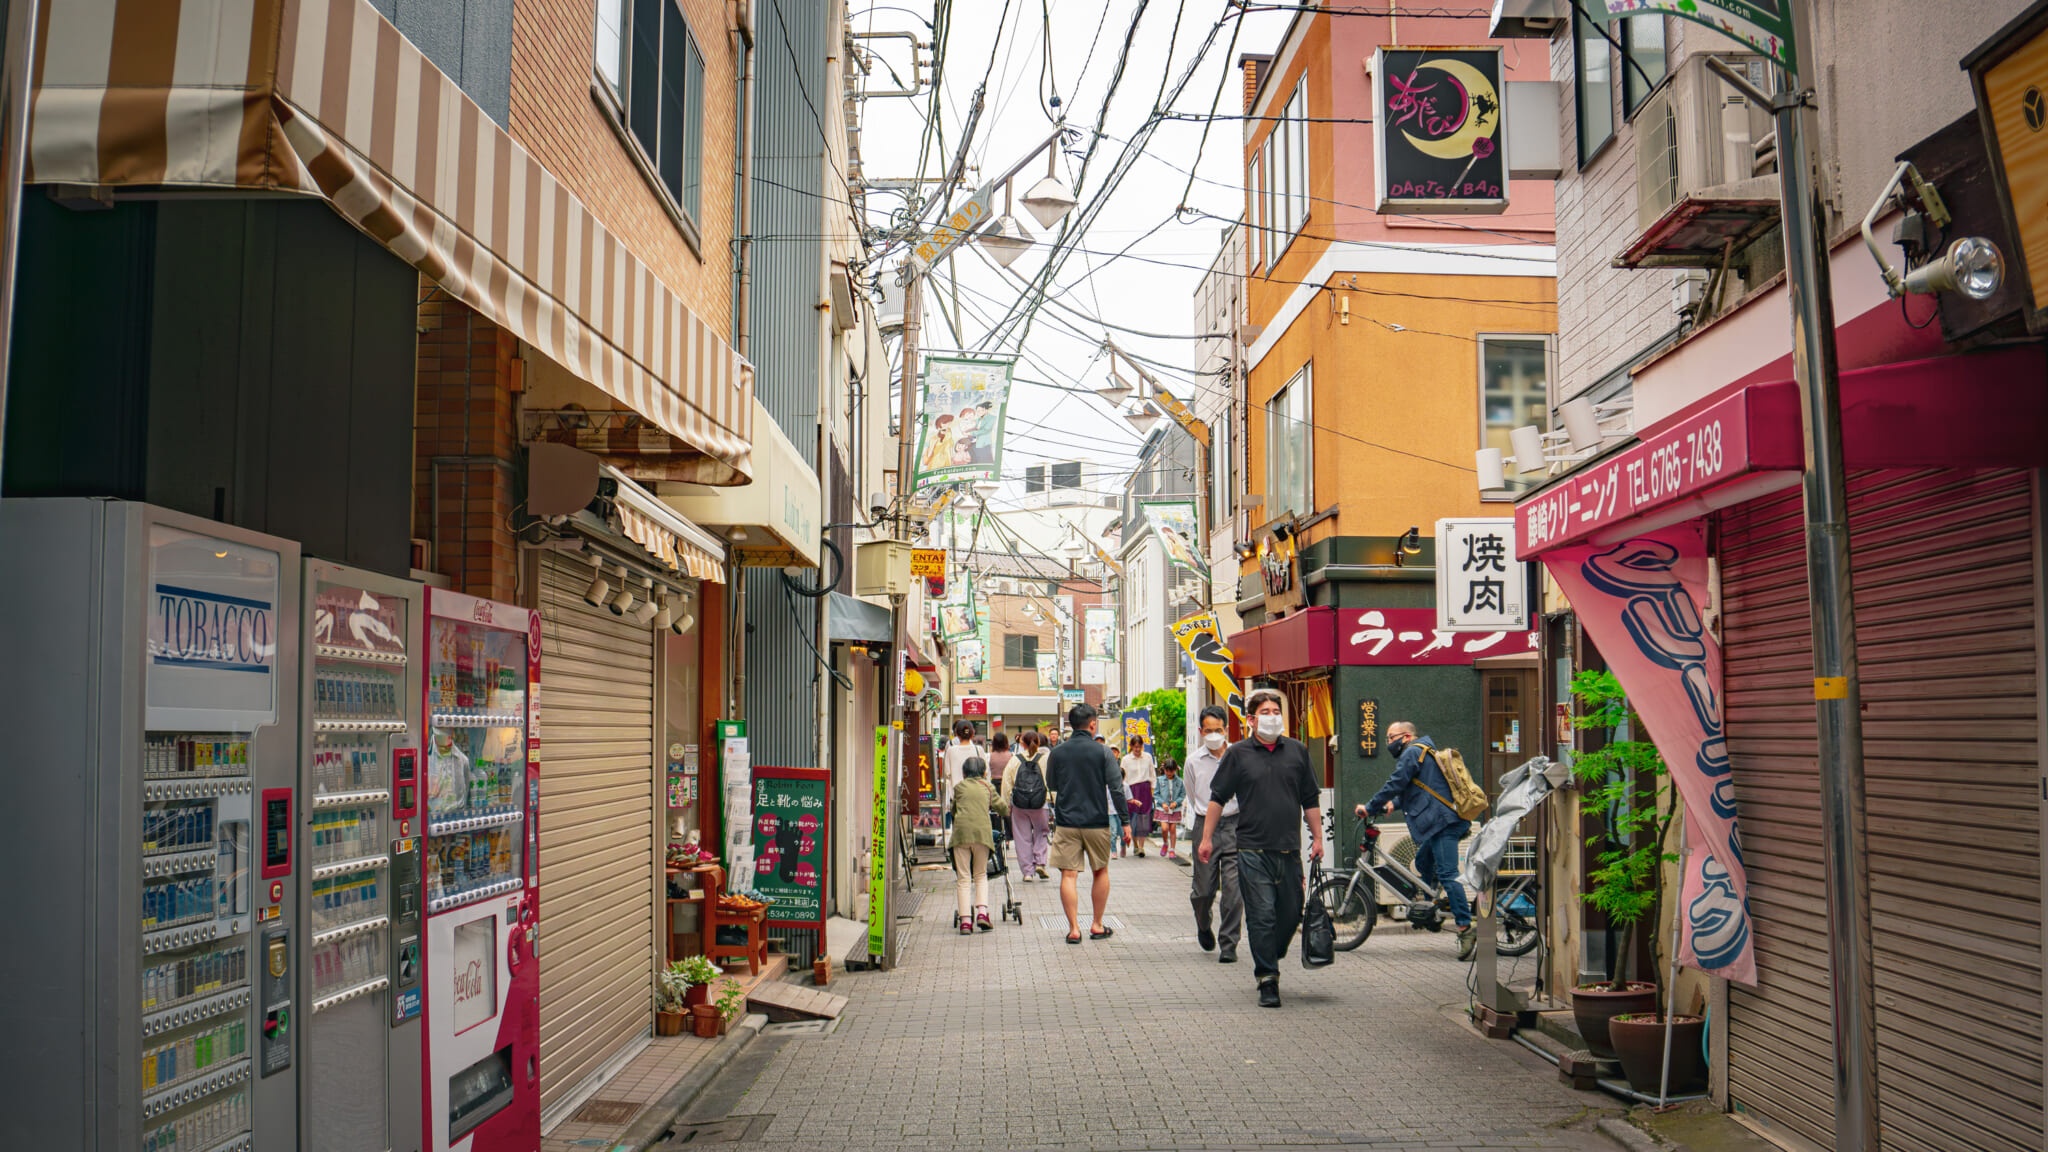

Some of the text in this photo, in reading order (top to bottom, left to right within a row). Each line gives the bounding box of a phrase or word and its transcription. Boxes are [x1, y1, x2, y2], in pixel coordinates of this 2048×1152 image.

[1390, 180, 1445, 198] DARTS
[1463, 180, 1500, 198] BAR
[915, 201, 982, 263] 教会通り
[1159, 391, 1201, 432] 教会通り
[1527, 419, 1723, 549] 藤崎クリーニング TEL 6765-7438
[1462, 532, 1507, 616] 焼肉
[159, 595, 267, 664] TOBACCO
[1360, 700, 1378, 756] 営業中
[756, 793, 823, 808] 足と靴の悩み
